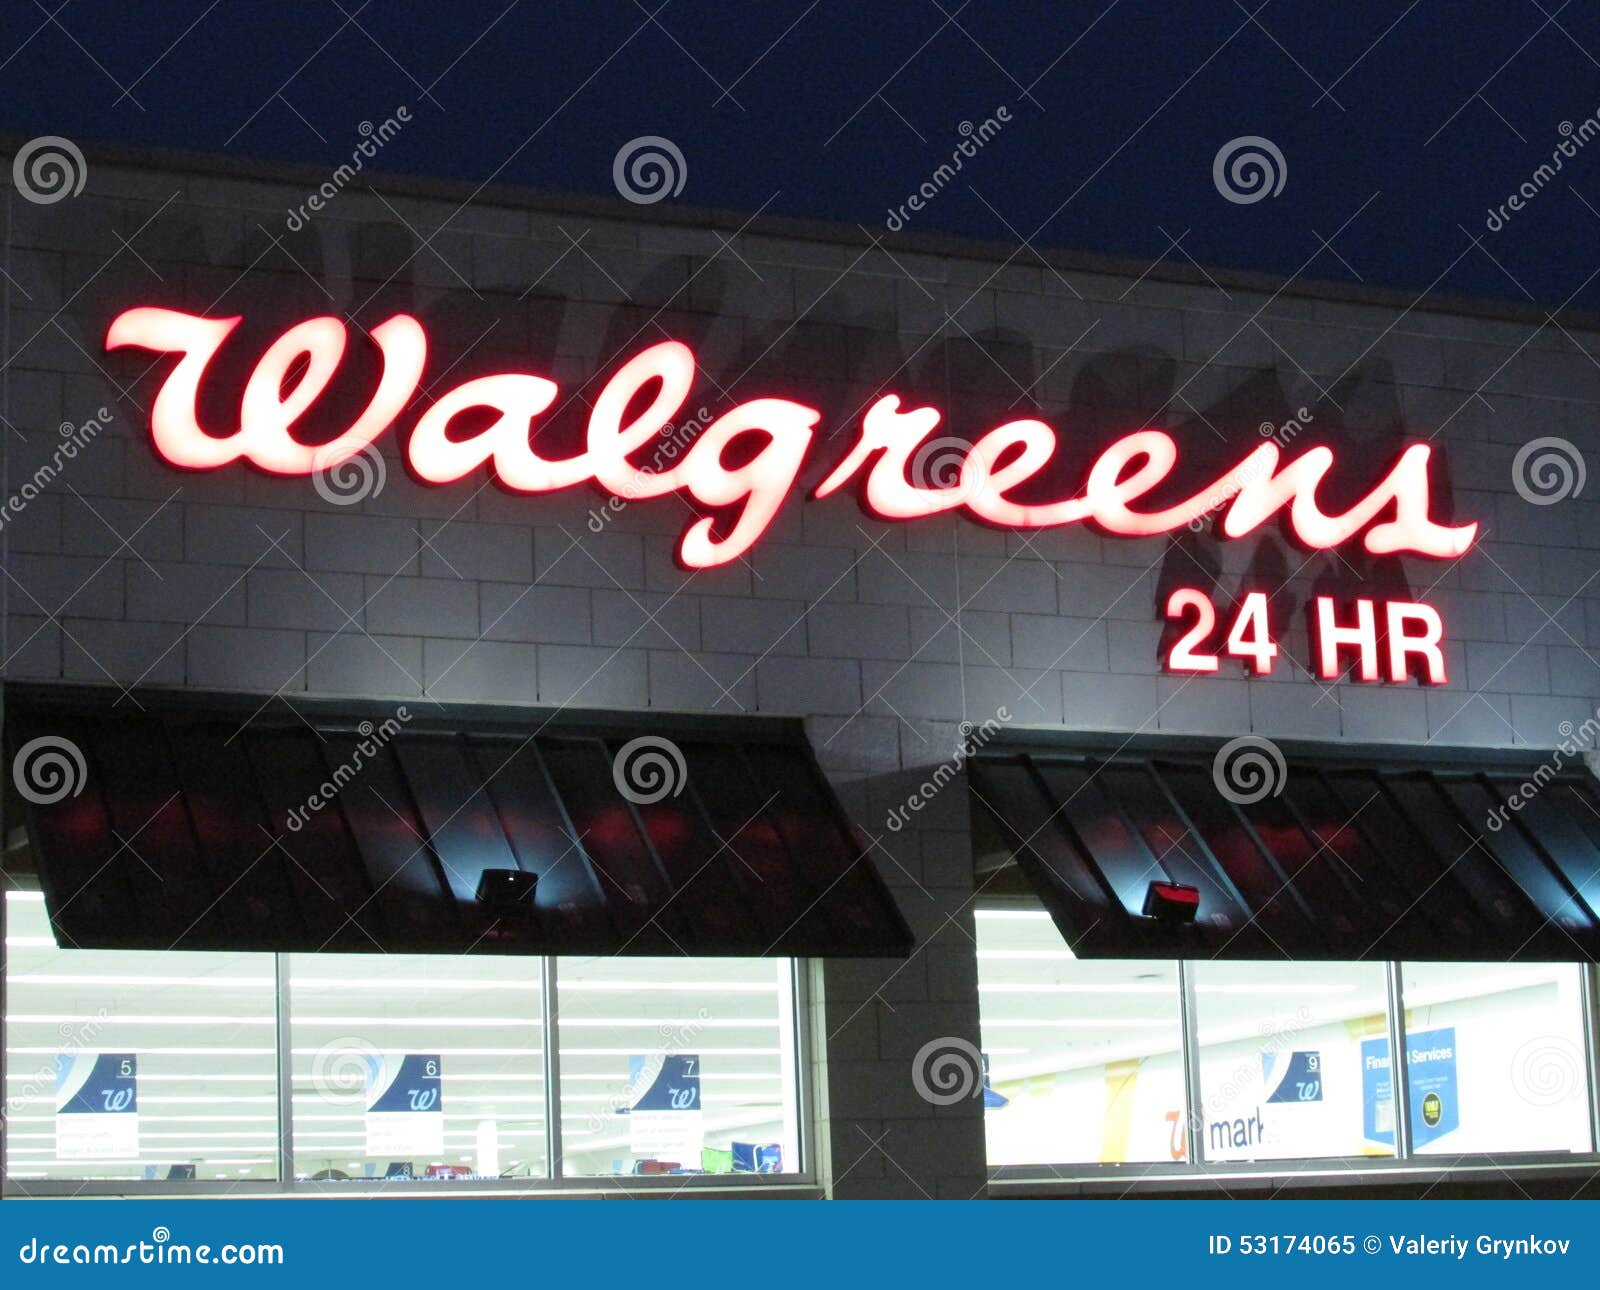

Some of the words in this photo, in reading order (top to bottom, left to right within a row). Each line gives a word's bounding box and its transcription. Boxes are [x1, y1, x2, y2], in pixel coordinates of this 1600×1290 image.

[105, 306, 1478, 569] Walgreens
[1164, 587, 1278, 675] 24
[1315, 595, 1449, 686] HR
[1308, 1055, 1318, 1071] 9
[1411, 1047, 1454, 1065] Services
[120, 1059, 132, 1076] 5
[425, 1060, 437, 1076] 6
[686, 1060, 695, 1076] 7
